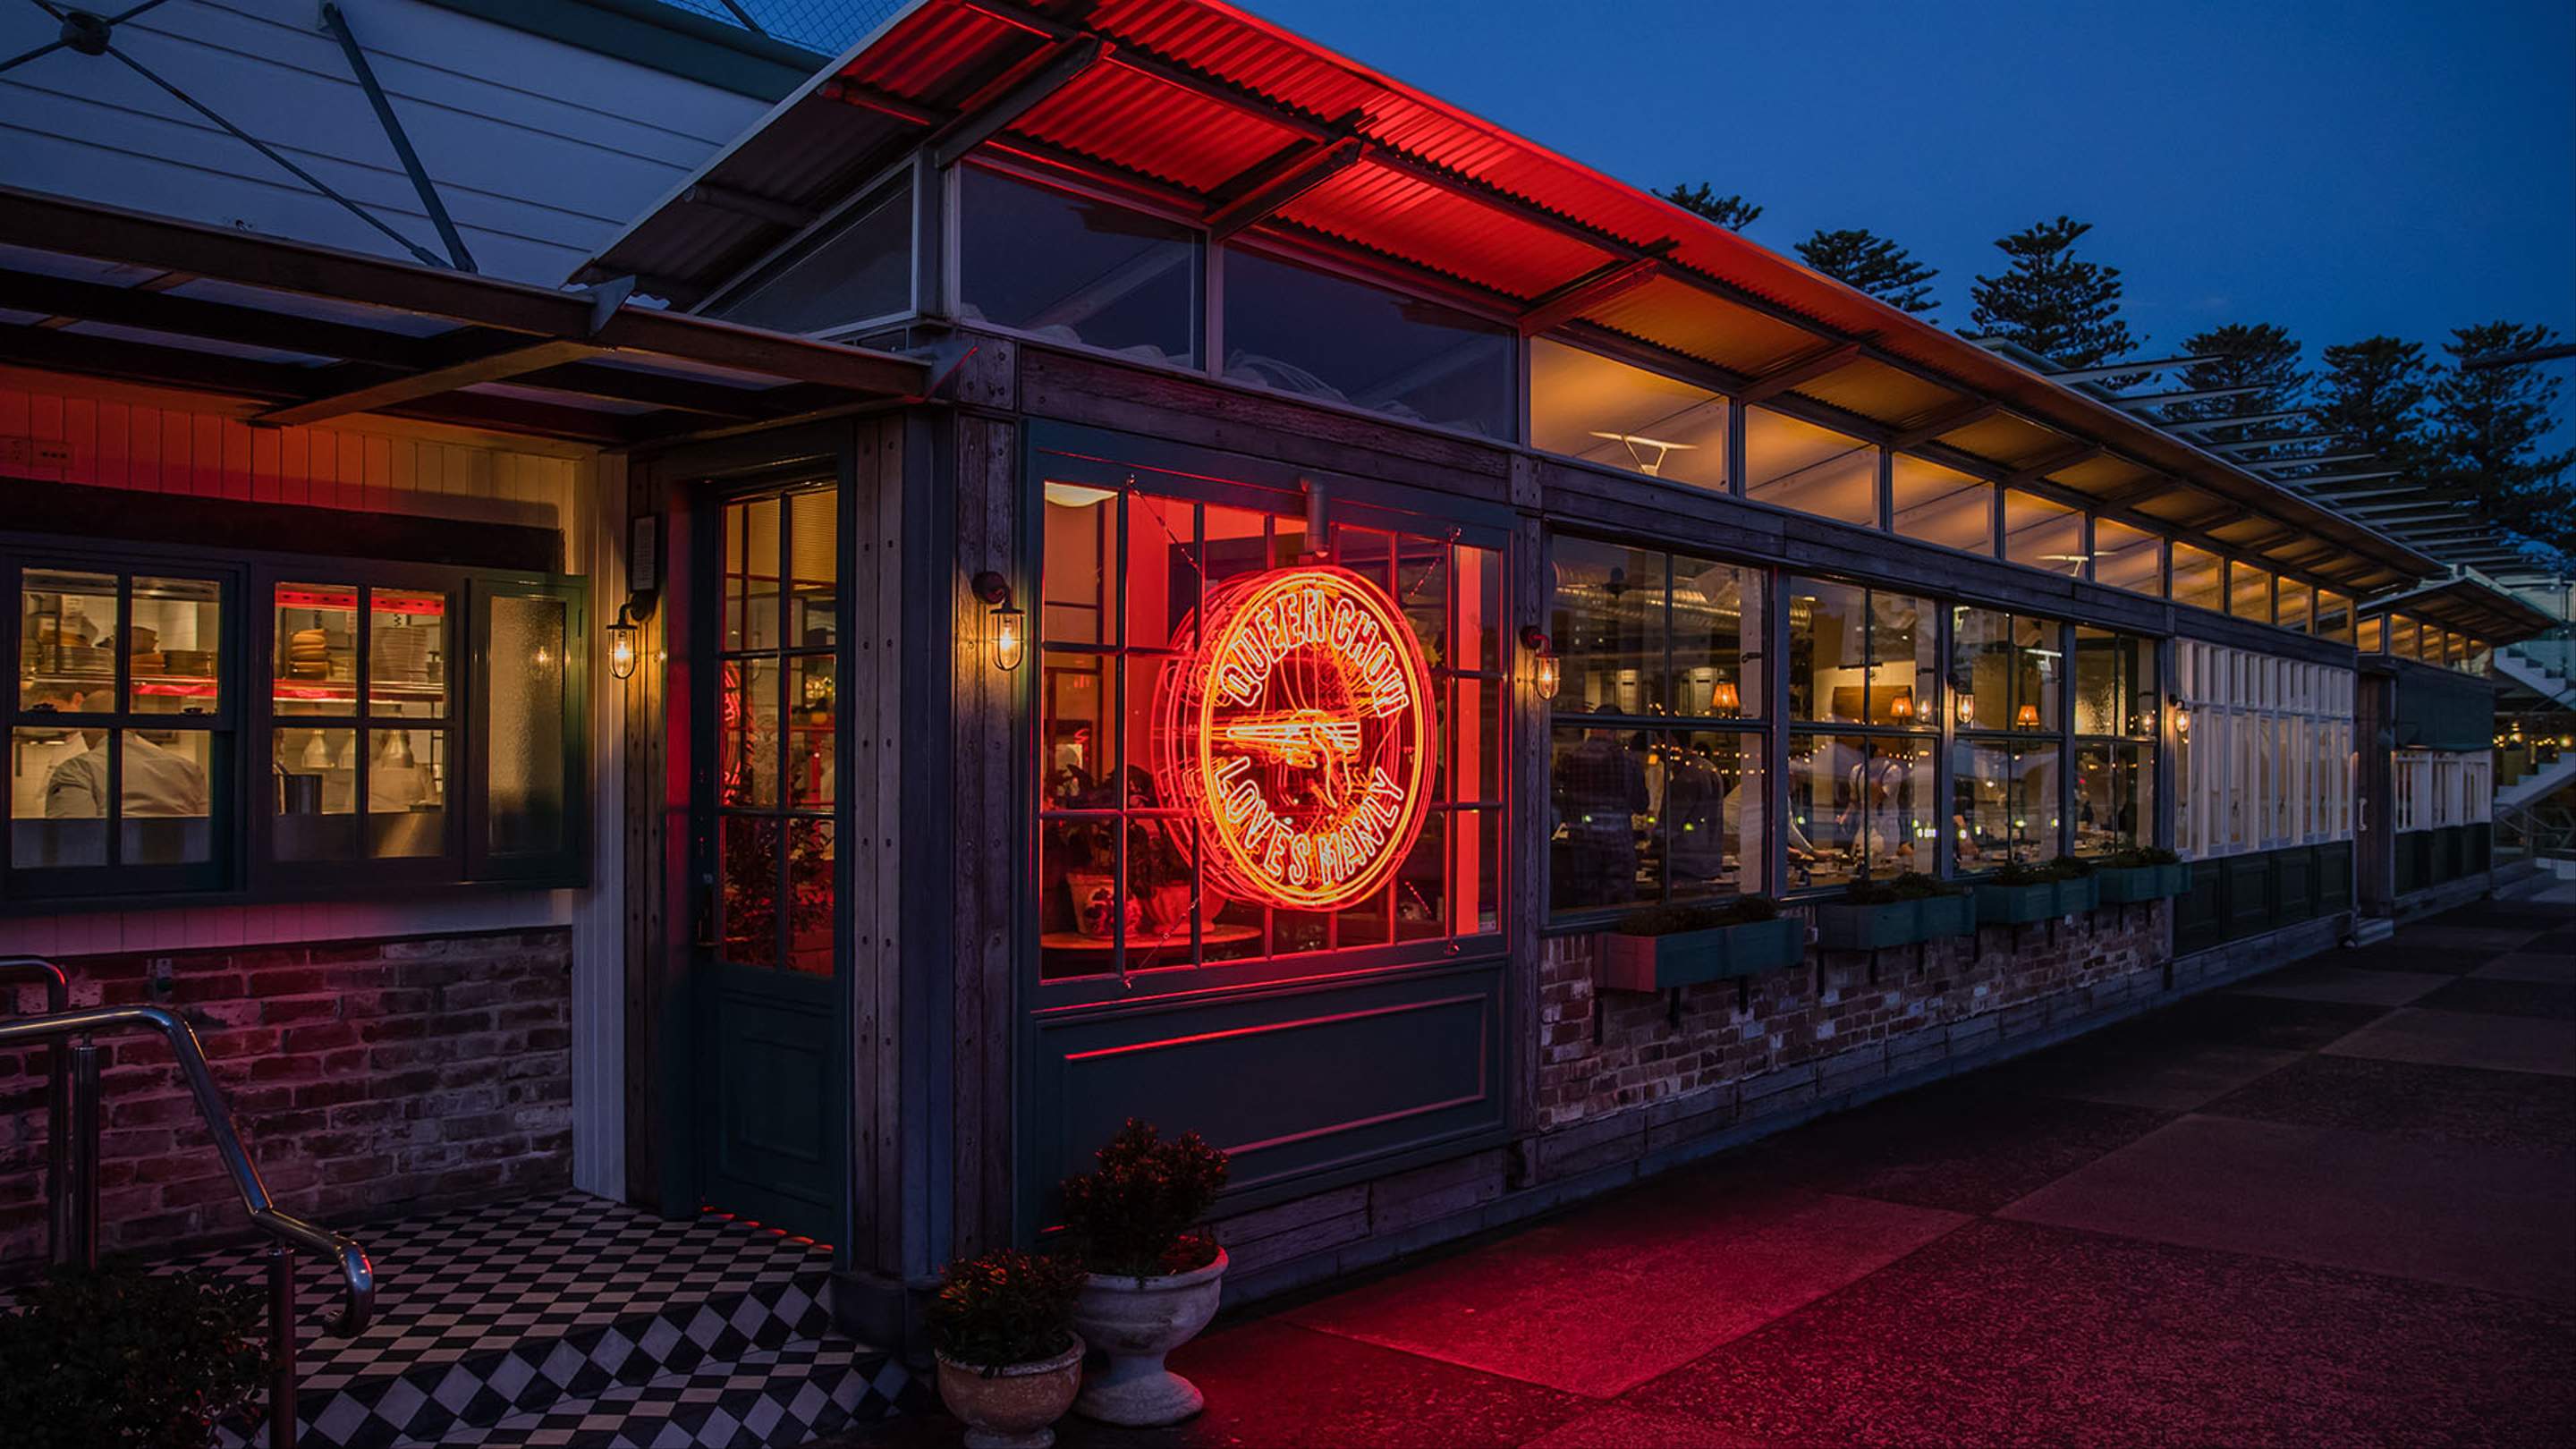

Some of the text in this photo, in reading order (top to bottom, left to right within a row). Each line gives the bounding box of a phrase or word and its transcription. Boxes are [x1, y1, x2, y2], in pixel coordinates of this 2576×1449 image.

[1220, 589, 1410, 717] QUEEN CHOW
[1215, 756, 1403, 886] LOVES MANLY
